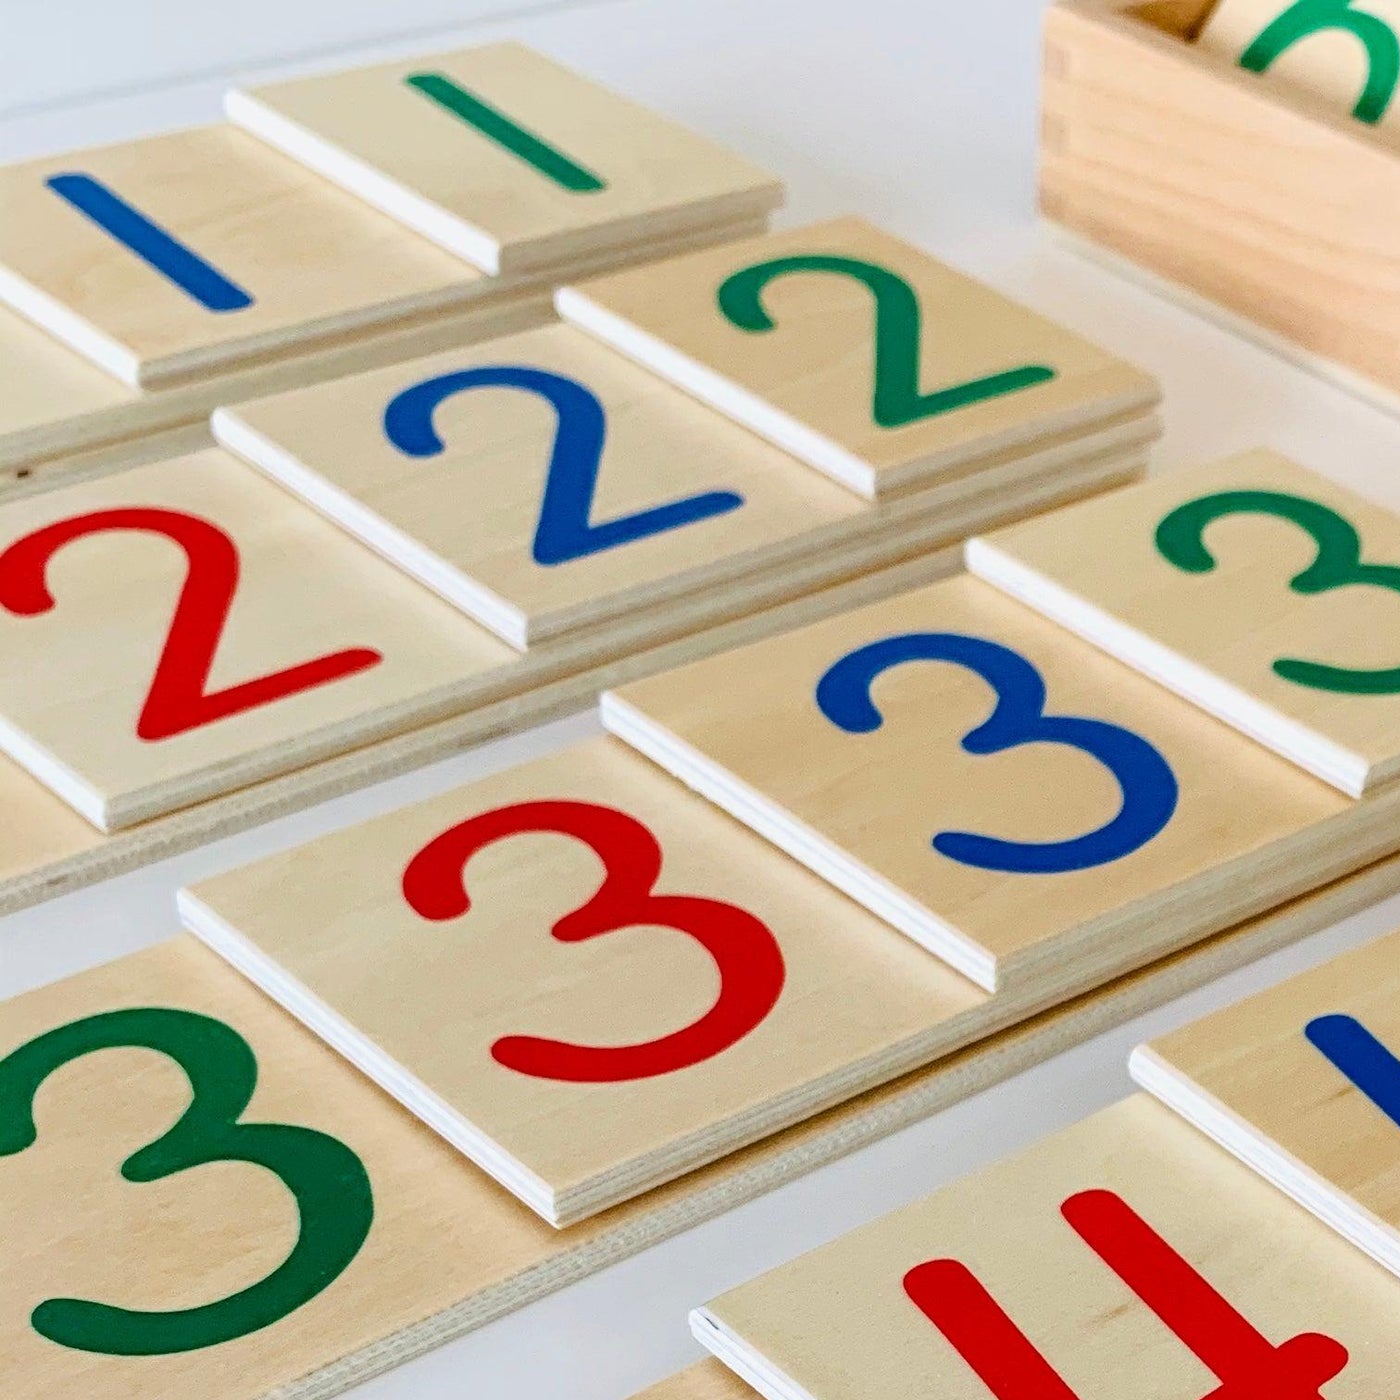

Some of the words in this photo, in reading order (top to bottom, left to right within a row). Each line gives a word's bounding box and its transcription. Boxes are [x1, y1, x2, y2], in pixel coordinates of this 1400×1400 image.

[46, 172, 254, 313] 1
[405, 72, 605, 193] 1
[0, 506, 383, 743] 2
[383, 365, 743, 567] 2
[716, 254, 1056, 429] 2
[0, 1006, 375, 1358] 3
[400, 798, 787, 1085] 3
[814, 632, 1179, 875] 3
